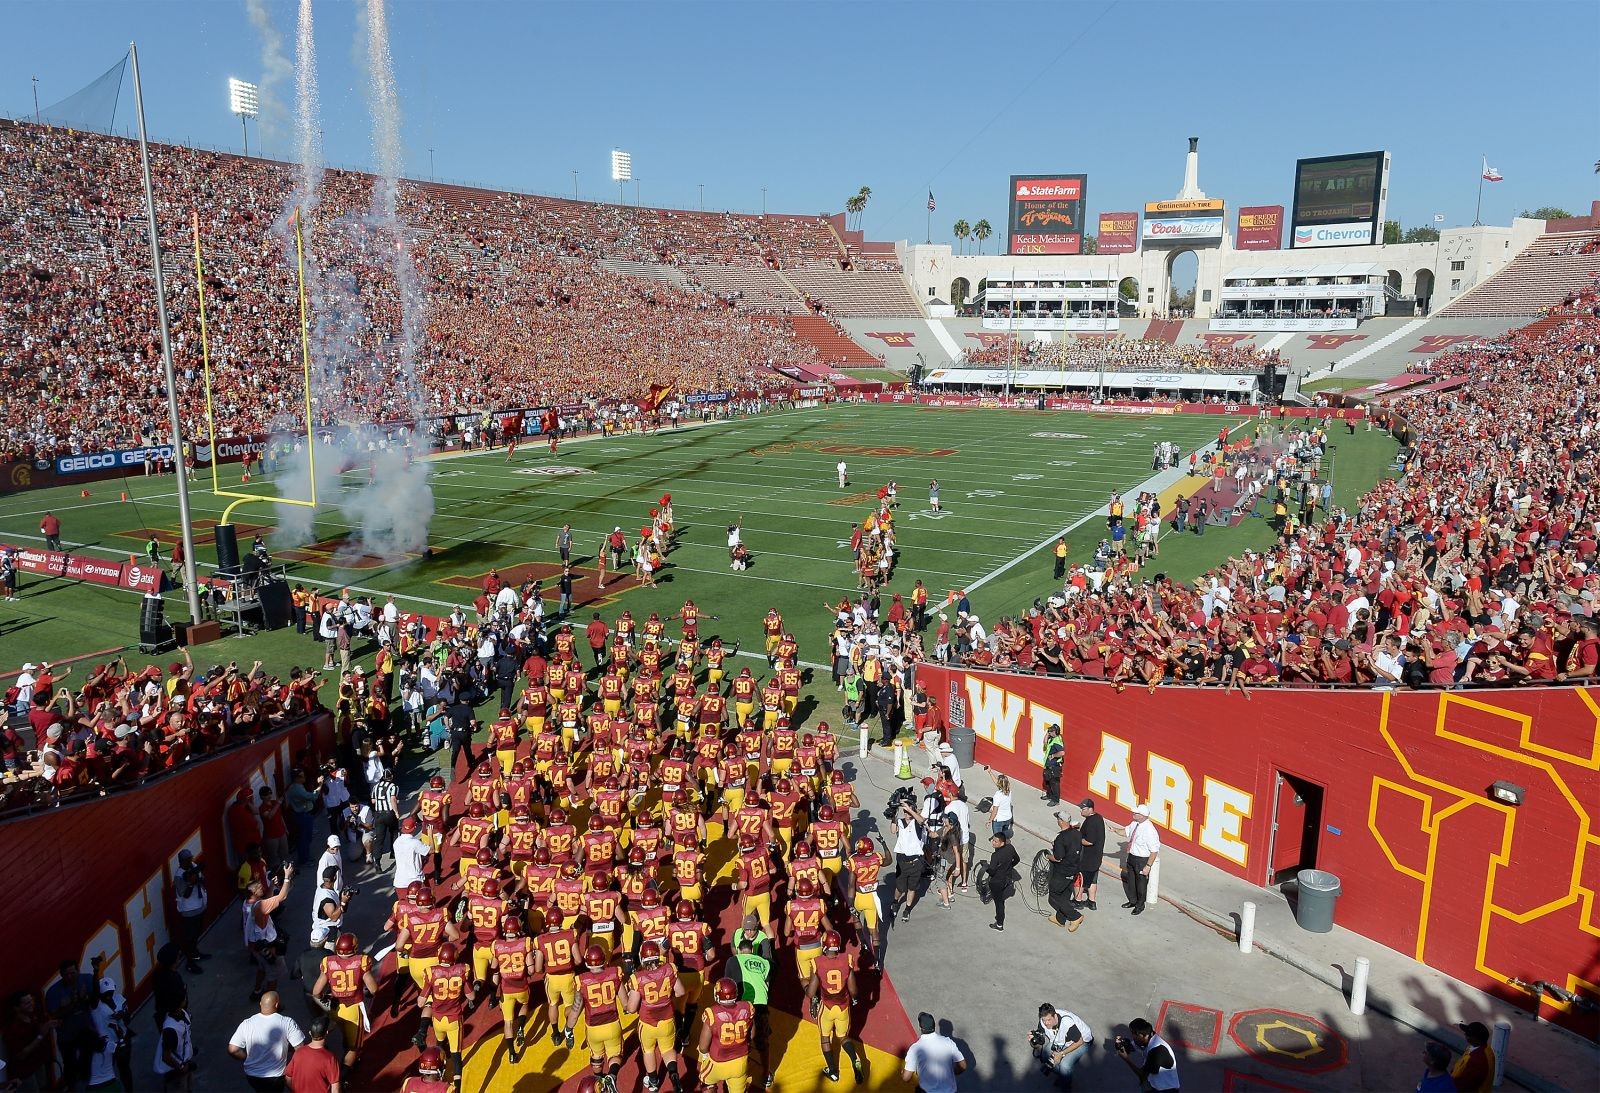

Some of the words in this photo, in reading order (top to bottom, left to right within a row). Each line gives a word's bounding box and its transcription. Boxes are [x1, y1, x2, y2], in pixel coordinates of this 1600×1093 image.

[1326, 178, 1355, 190] ARE
[1156, 202, 1191, 211] Continental
[1020, 209, 1073, 226] Trojans
[1151, 223, 1183, 234] Coors
[1182, 224, 1214, 234] LIGHT
[1317, 229, 1371, 240] Chevron
[1017, 234, 1037, 244] Keck
[1039, 234, 1075, 244] Medicine
[1017, 245, 1025, 254] of
[1027, 245, 1046, 254] USC
[686, 394, 706, 402] GEICO
[59, 453, 115, 471] GEICO
[121, 446, 172, 465] GECO
[94, 567, 120, 578] HYUNDAI
[685, 610, 696, 618] 10
[617, 621, 629, 632] 18
[557, 640, 570, 651] 22
[778, 646, 793, 657] 47
[644, 654, 658, 666] 52
[569, 676, 577, 689] 8
[606, 680, 618, 692] 91
[675, 678, 690, 690] 57
[736, 681, 750, 694] 90
[784, 673, 798, 686] 65
[530, 692, 544, 705] 51
[702, 698, 720, 712] 73
[560, 708, 576, 720] 26
[637, 708, 653, 721] 44
[678, 702, 694, 716] 42
[497, 726, 514, 741] 74
[537, 740, 554, 752] 26
[700, 744, 719, 759] 45
[745, 736, 761, 752] 34
[776, 736, 794, 751] 62
[594, 762, 612, 776] 46
[664, 766, 682, 783] 99
[548, 770, 564, 787] 14
[472, 786, 490, 802] 87
[514, 786, 526, 802] 4
[1088, 731, 1254, 868] ARE
[421, 799, 440, 818] 82
[600, 800, 620, 816] 40
[772, 802, 796, 820] 24
[676, 812, 696, 831] 98
[740, 816, 761, 834] 72
[461, 824, 482, 844] 67
[512, 832, 534, 850] 79
[817, 830, 838, 848] 59
[550, 834, 572, 852] 92
[590, 842, 612, 862] 68
[676, 860, 695, 879] 38
[750, 856, 769, 878] 61
[858, 865, 879, 883] 22
[528, 876, 553, 893] 54
[472, 906, 497, 928] 53
[590, 898, 614, 920] 50
[642, 916, 666, 937] 25
[794, 910, 820, 931] 44
[414, 922, 440, 944] 77
[672, 930, 698, 954] 63
[544, 940, 571, 967] 19
[332, 970, 358, 992] 31
[434, 976, 463, 1000] 39
[826, 969, 842, 995] 9
[586, 980, 616, 1008] 50
[644, 976, 671, 1004] 64
[720, 1020, 748, 1046] 60
